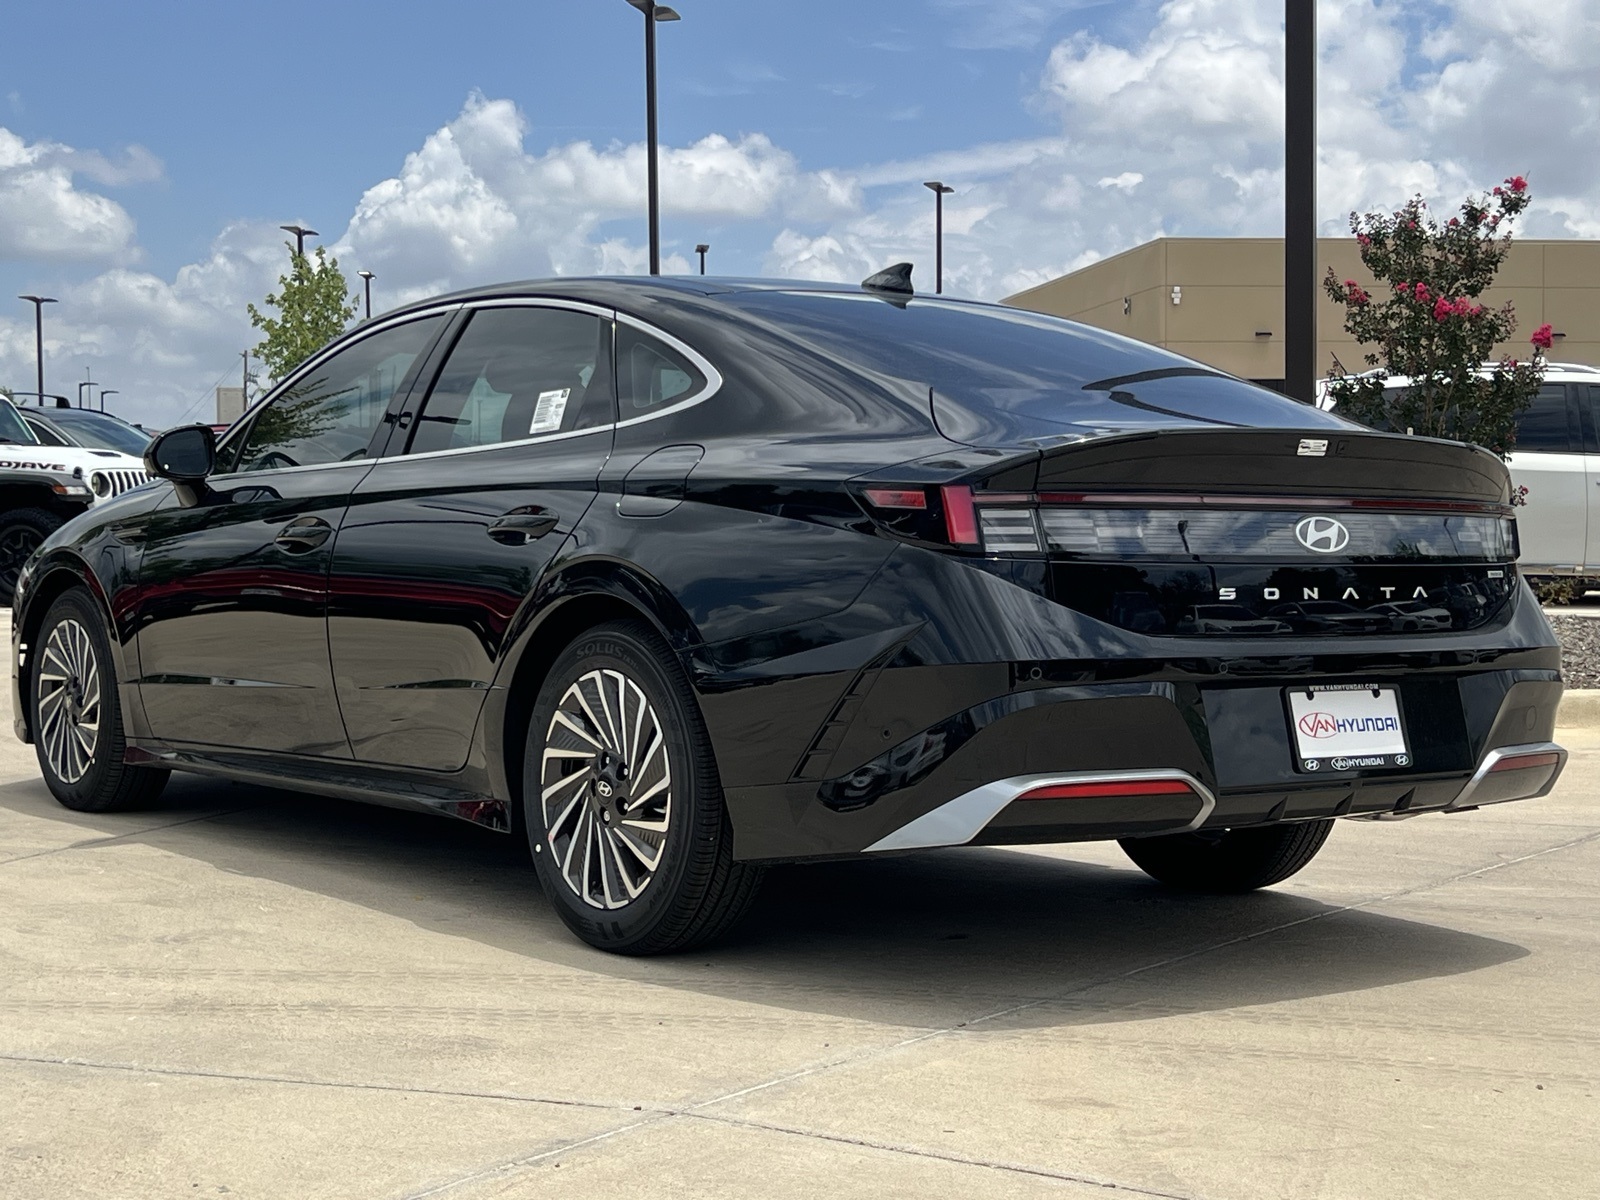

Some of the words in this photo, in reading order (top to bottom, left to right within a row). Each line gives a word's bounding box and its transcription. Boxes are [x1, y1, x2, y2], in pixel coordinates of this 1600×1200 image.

[1218, 586, 1429, 601] SONATA
[576, 642, 624, 659] SOLUS
[1308, 683, 1379, 692] WWW.VANHYUNDAI.COM
